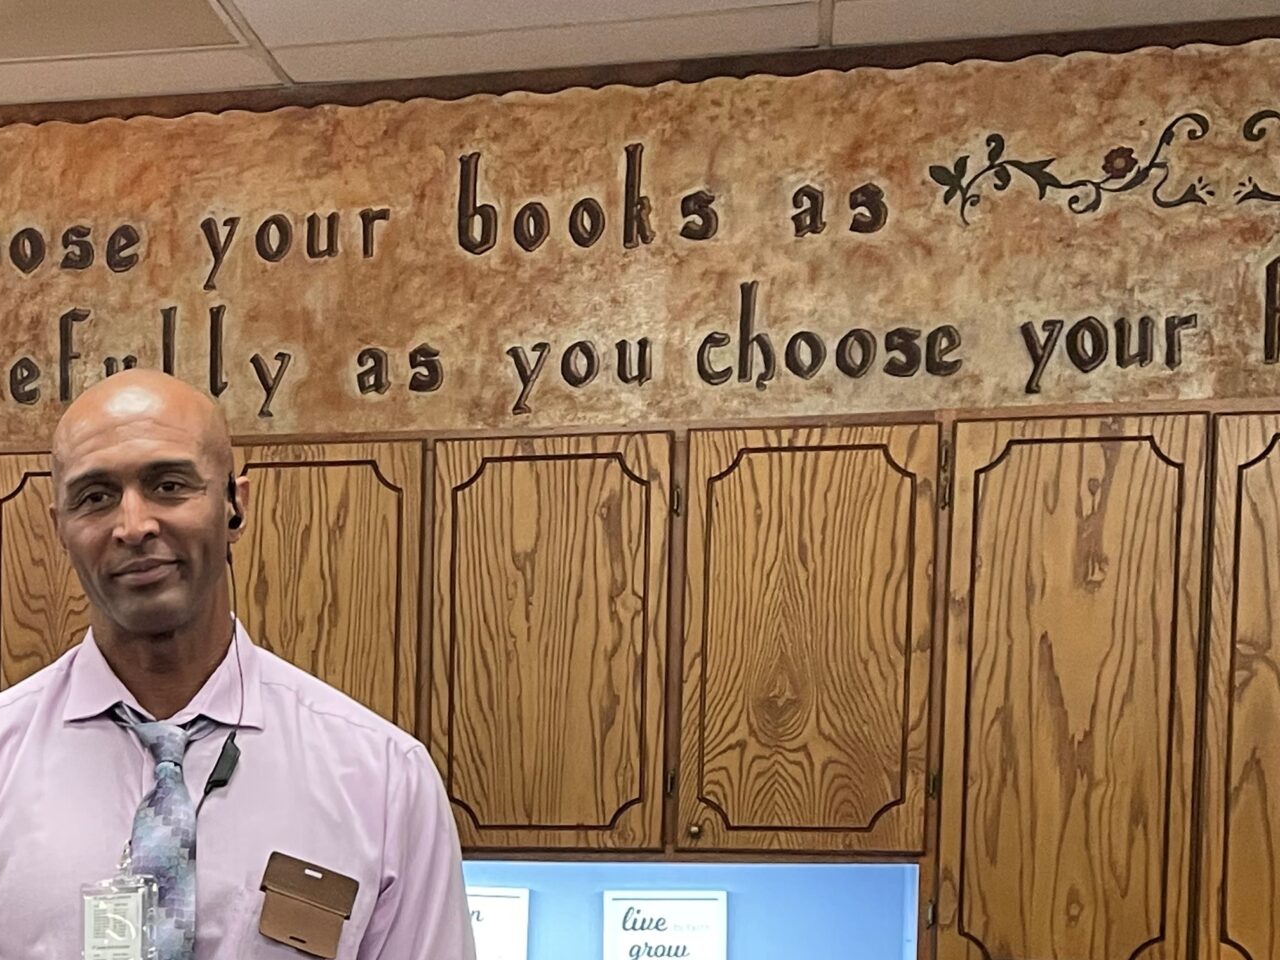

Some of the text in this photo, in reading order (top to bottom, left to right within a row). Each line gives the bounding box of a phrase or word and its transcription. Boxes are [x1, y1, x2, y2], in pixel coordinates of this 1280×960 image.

[201, 208, 390, 290] your
[457, 143, 719, 255] books
[792, 183, 888, 238] as
[356, 343, 443, 395] as
[508, 337, 652, 415] you
[697, 280, 962, 391] choose
[1021, 313, 1197, 393] your
[622, 907, 668, 932] live
